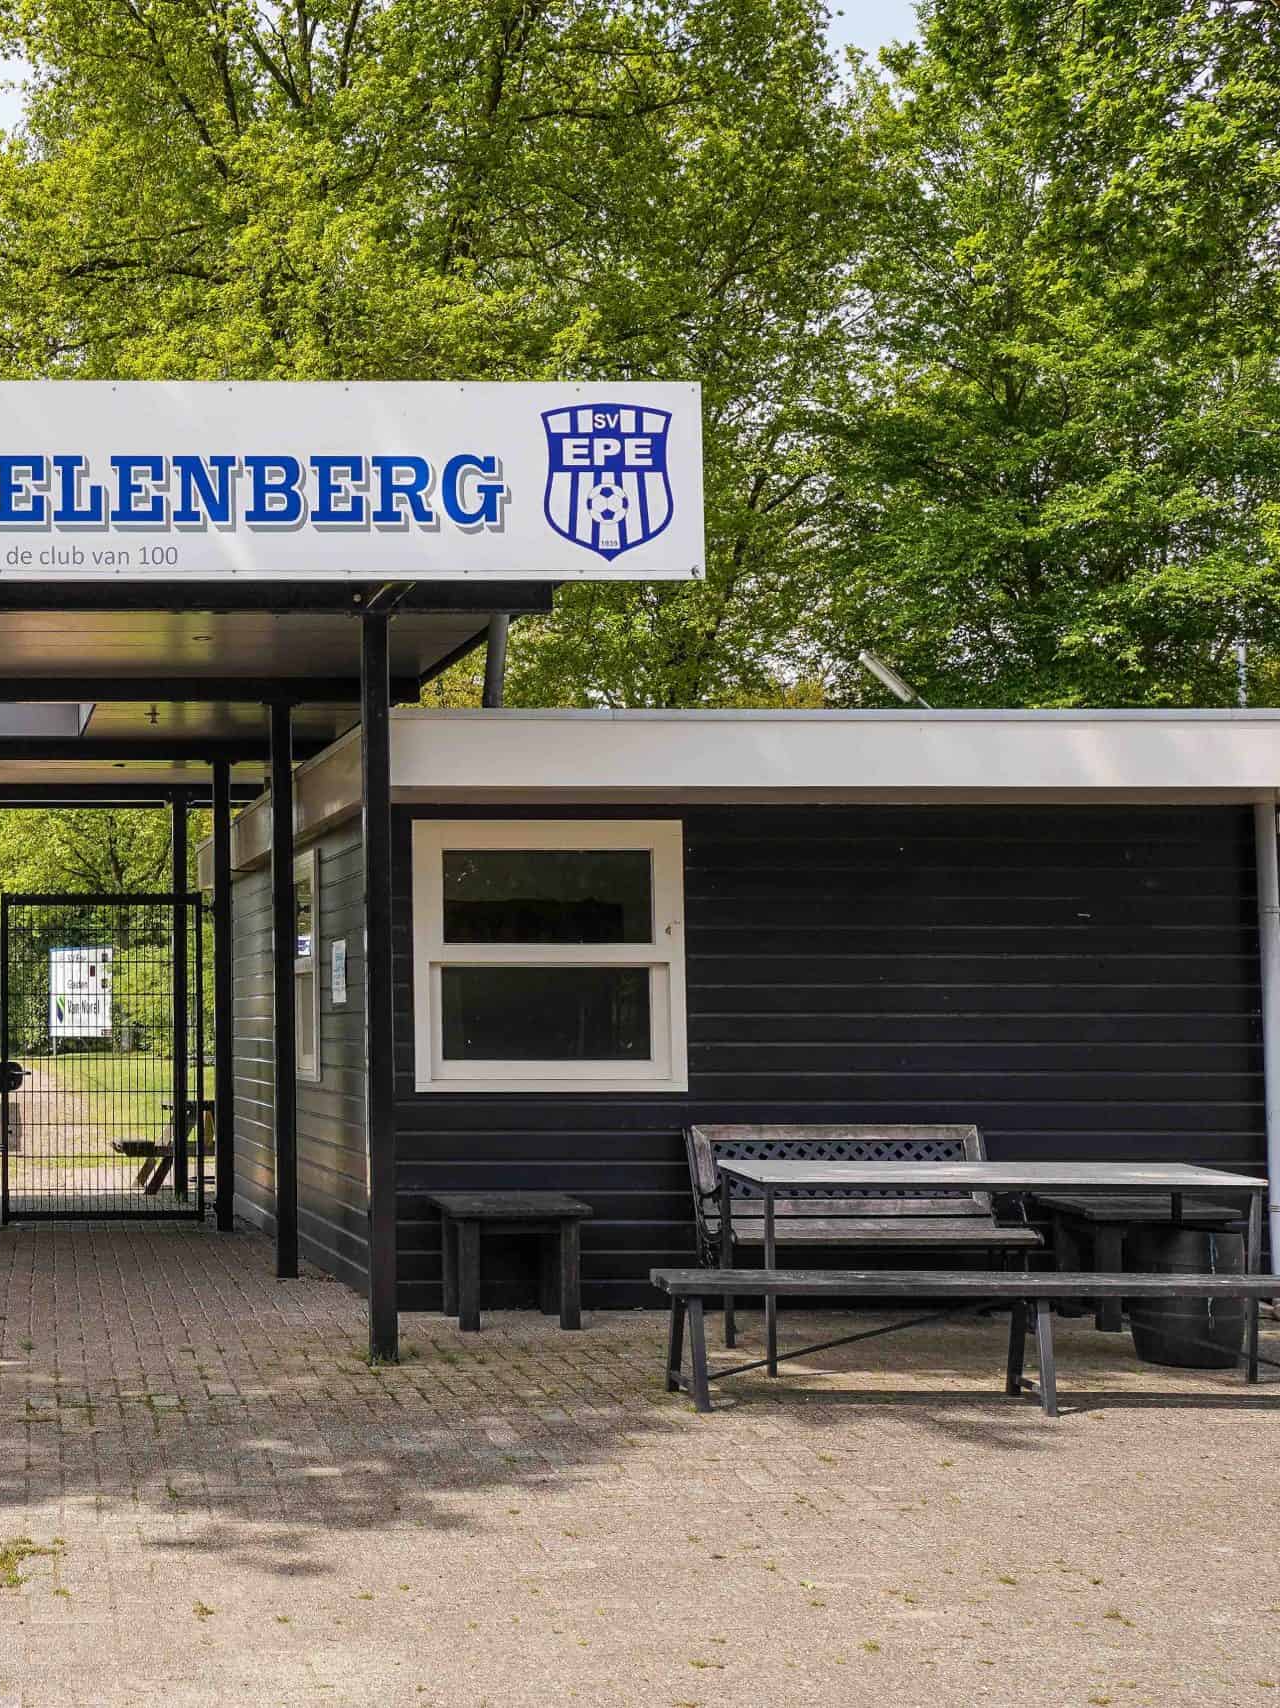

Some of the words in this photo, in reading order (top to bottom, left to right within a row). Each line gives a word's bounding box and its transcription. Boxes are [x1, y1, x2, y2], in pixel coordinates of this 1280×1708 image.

[593, 411, 621, 429] SV
[562, 437, 654, 467] EPE
[6, 547, 33, 566] de
[39, 547, 85, 566] club
[92, 551, 132, 566] van
[138, 548, 179, 566] 100
